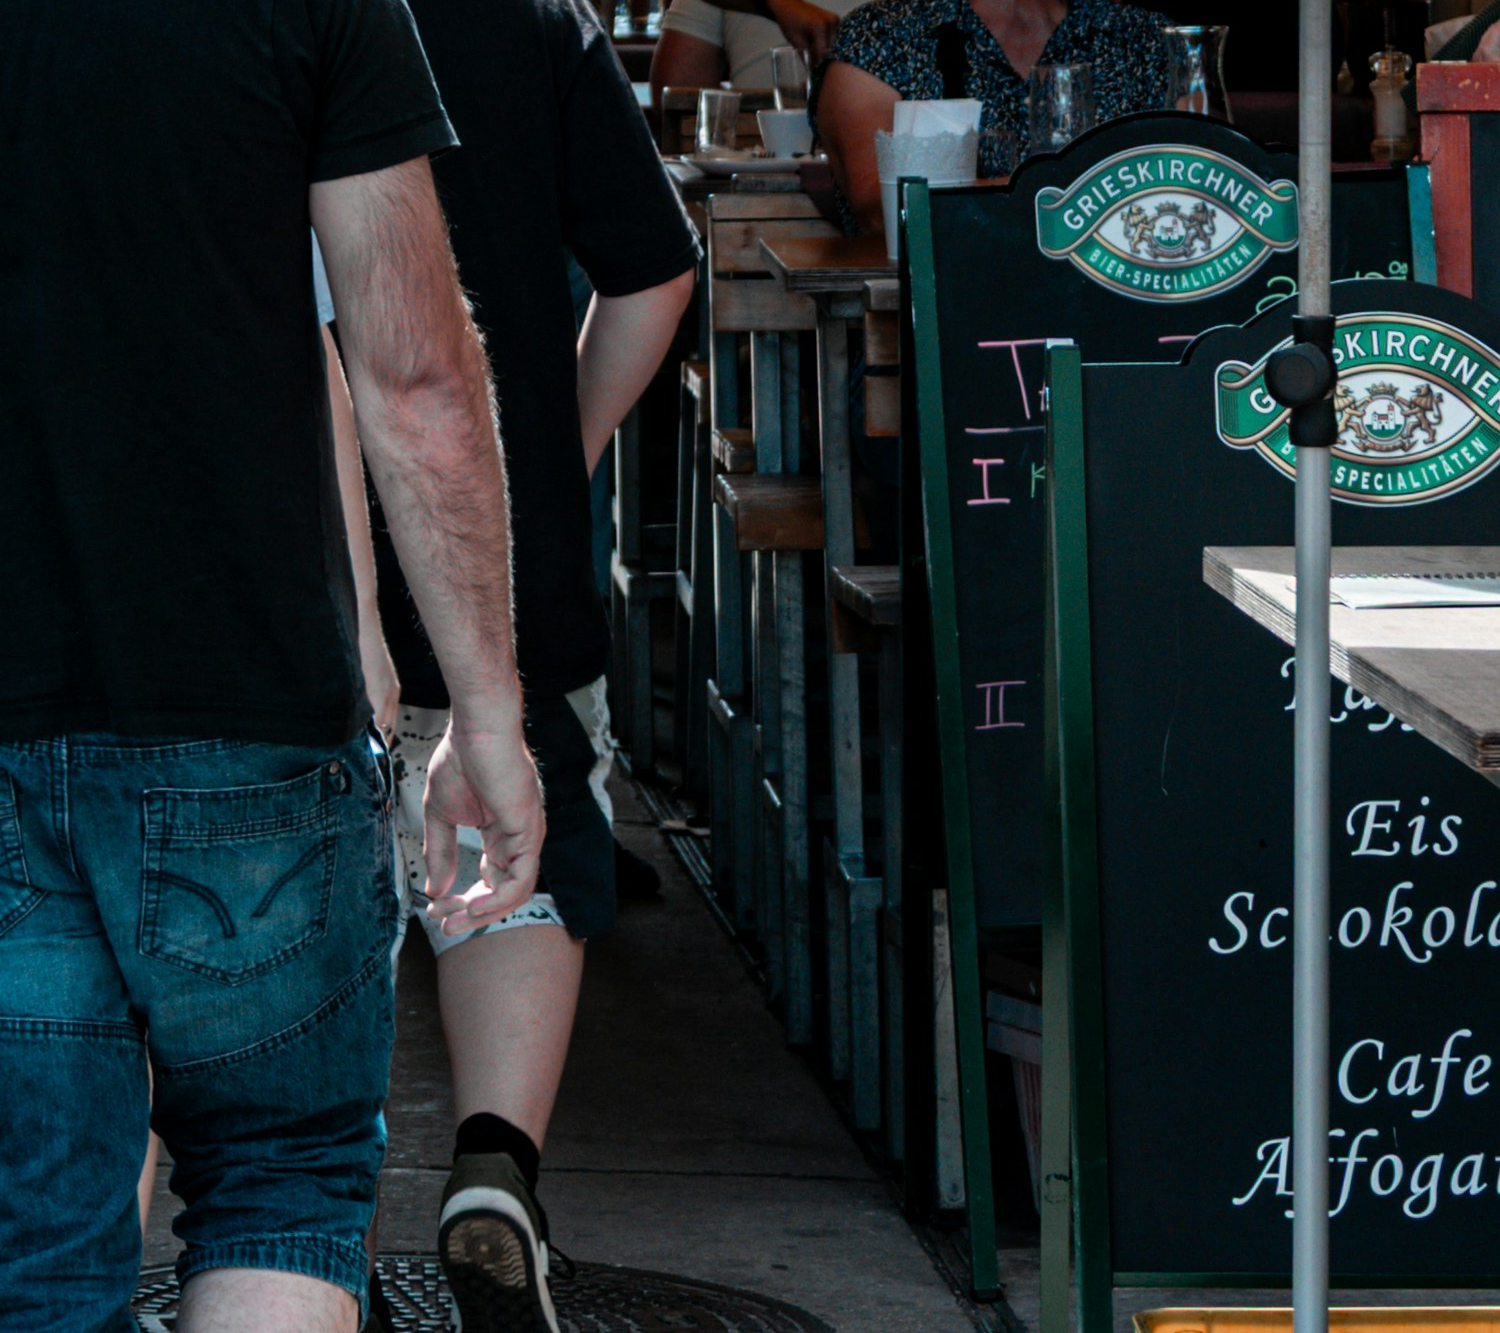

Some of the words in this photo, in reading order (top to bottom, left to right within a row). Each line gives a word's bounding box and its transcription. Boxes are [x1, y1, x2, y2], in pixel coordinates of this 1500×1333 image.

[1063, 158, 1274, 230] GRIESKIRCHNER
[1346, 796, 1463, 857] Eis
[1338, 1028, 1492, 1118] Cafe
